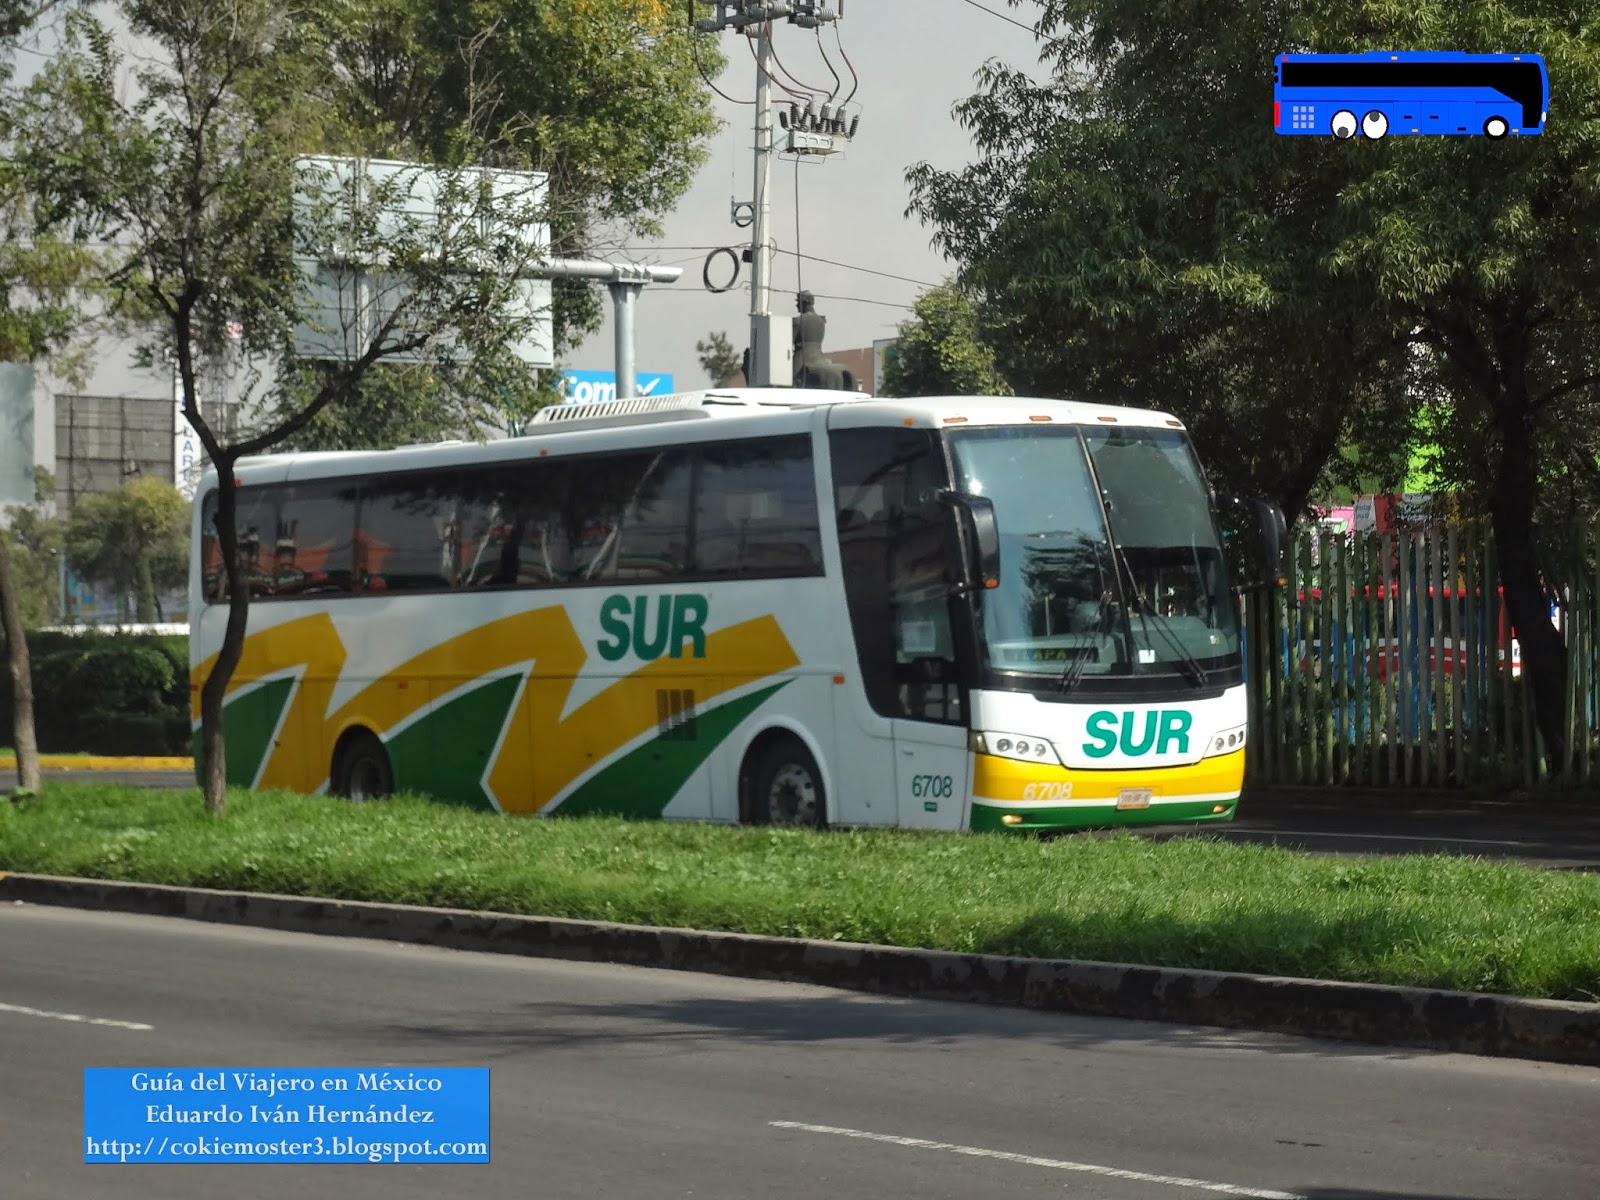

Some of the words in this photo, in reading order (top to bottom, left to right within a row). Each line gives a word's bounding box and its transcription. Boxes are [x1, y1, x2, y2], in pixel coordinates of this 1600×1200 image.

[597, 593, 709, 661] SUR
[1082, 710, 1192, 758] SUR
[912, 775, 953, 798] 6708
[1023, 781, 1073, 801] 6708
